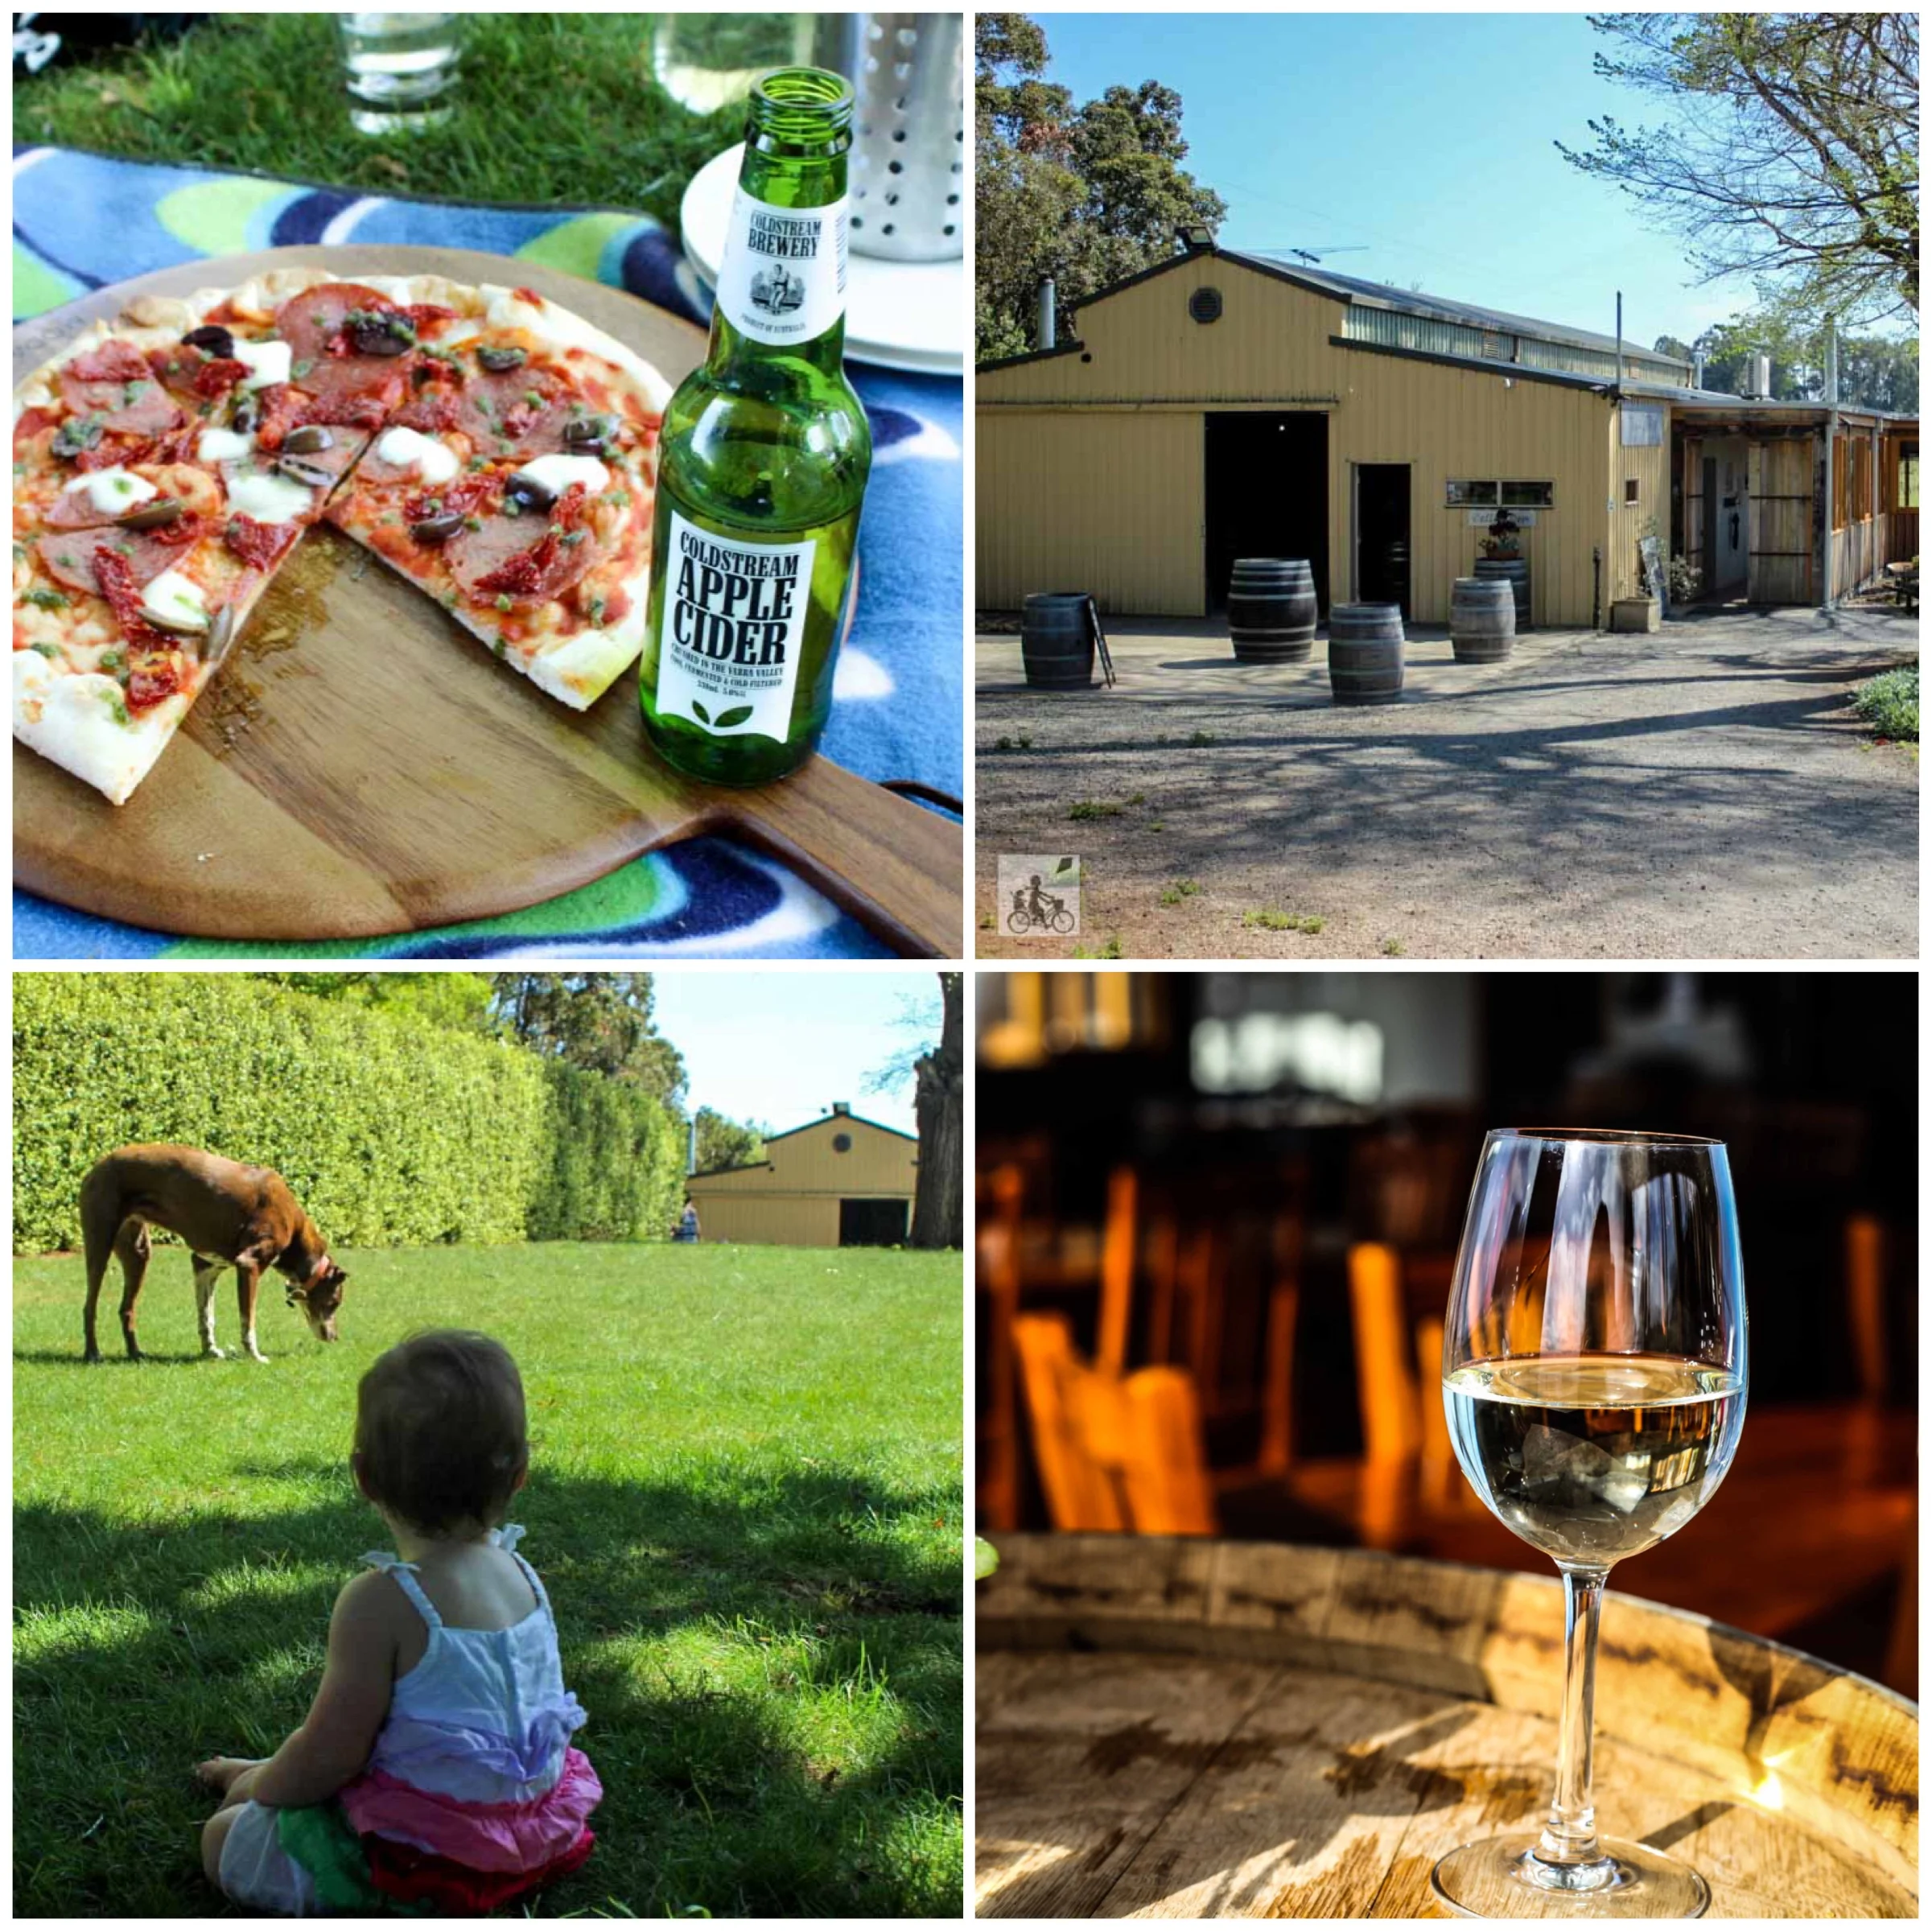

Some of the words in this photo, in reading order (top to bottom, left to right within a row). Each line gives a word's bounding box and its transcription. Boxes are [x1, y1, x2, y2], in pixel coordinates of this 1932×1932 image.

[748, 229, 818, 257] BREWERY
[680, 531, 800, 577] COLDSTREAM
[676, 555, 797, 620] APPLE
[674, 599, 788, 665] CIDER
[711, 661, 726, 674] THE
[728, 666, 754, 678] YARRA
[756, 667, 784, 678] VALLEY
